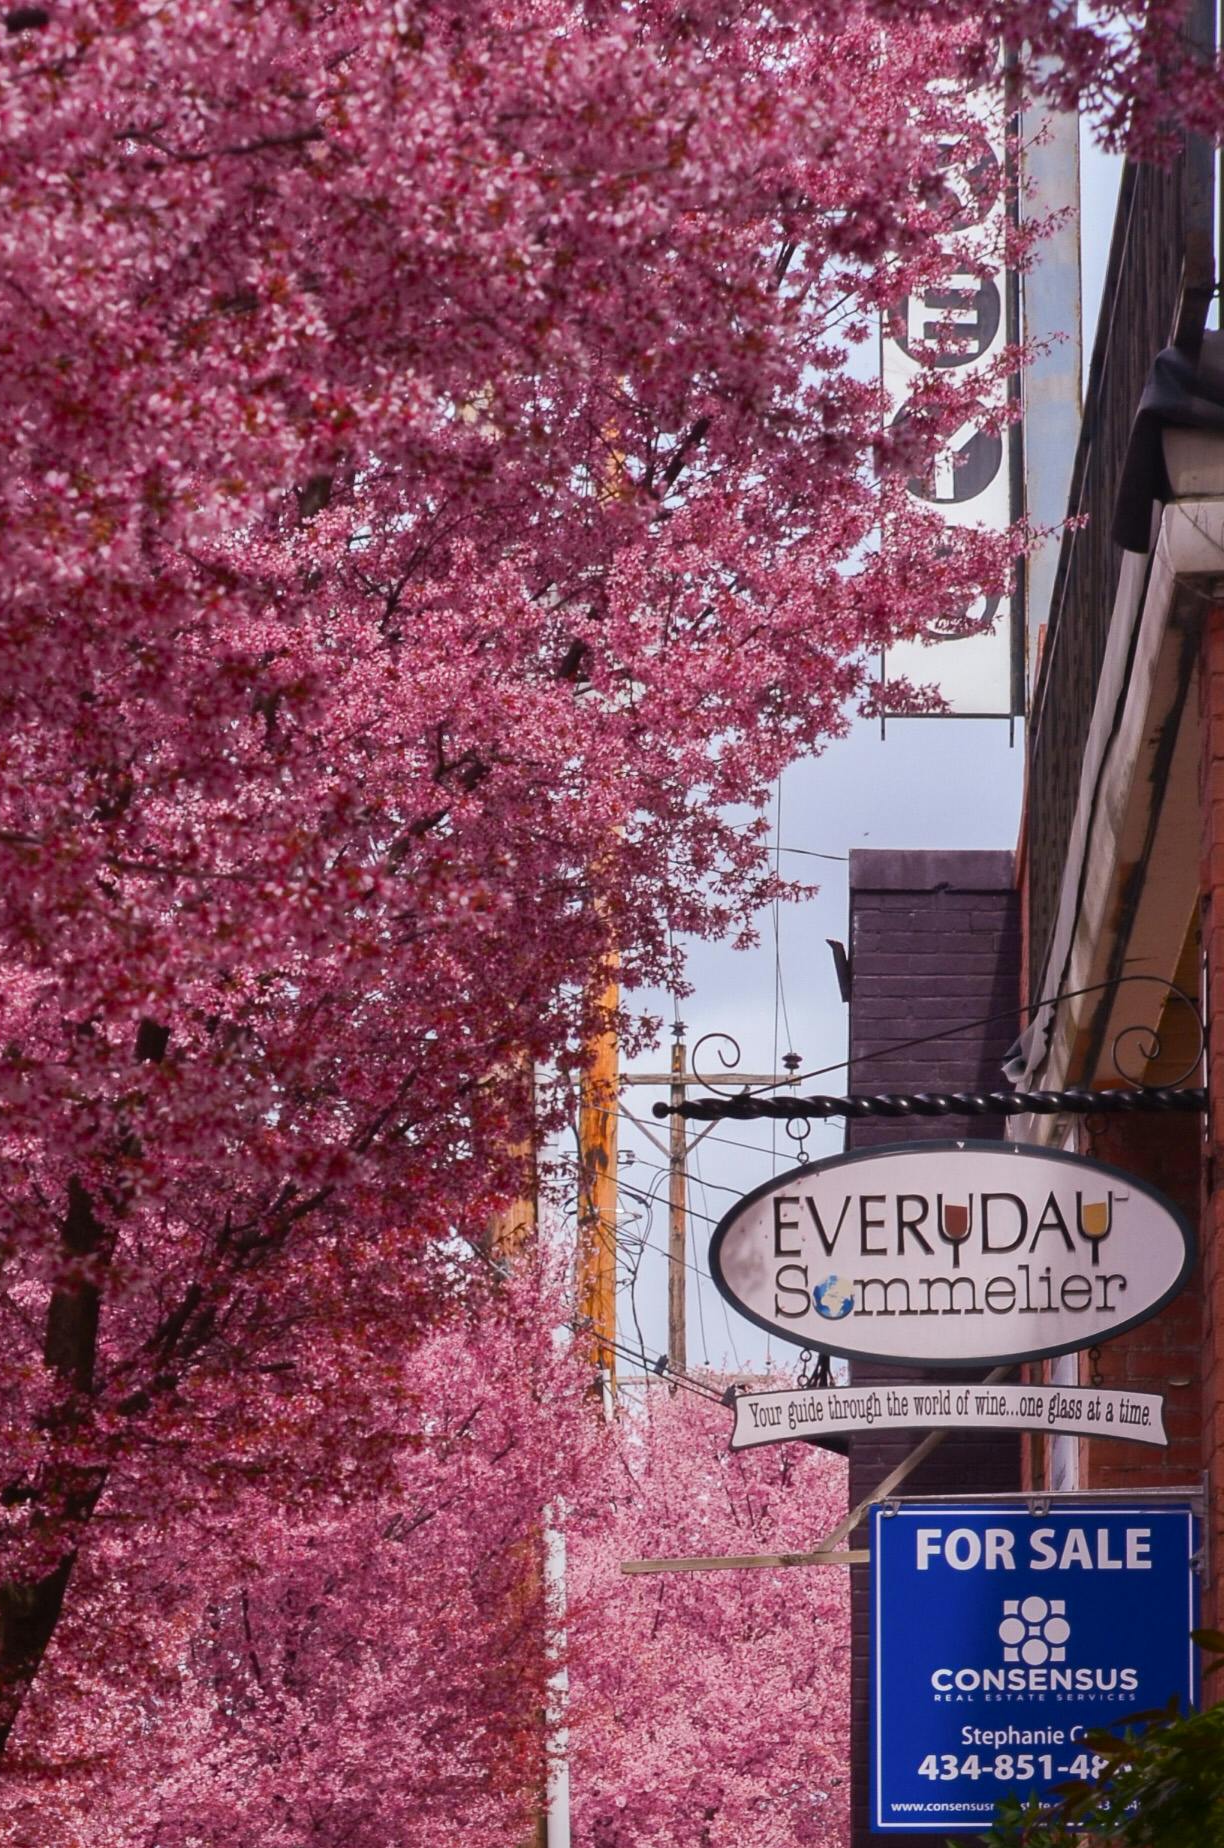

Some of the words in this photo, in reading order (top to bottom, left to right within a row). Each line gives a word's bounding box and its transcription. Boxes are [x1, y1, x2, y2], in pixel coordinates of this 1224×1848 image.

[774, 1190, 1113, 1268] EVERYDAY
[775, 1264, 1128, 1320] Sommelier
[749, 1402, 782, 1429] Your
[788, 1397, 824, 1430] guide
[828, 1393, 882, 1424] through
[887, 1391, 908, 1417] the
[914, 1390, 951, 1417] world
[956, 1390, 969, 1416] of
[1048, 1392, 1082, 1424] glass
[1087, 1395, 1101, 1421] at
[1105, 1402, 1114, 1422] a
[1119, 1396, 1152, 1426] time.
[917, 1528, 1016, 1571] FOR
[1029, 1528, 1152, 1570] SALE
[931, 1668, 1138, 1691] CONSENSUS
[934, 1693, 974, 1702] REAL
[985, 1693, 1045, 1702] ESTATE
[1056, 1693, 1136, 1702] SERVICES
[961, 1725, 1064, 1750] Stephanie
[918, 1754, 1110, 1781] 434-851-48
